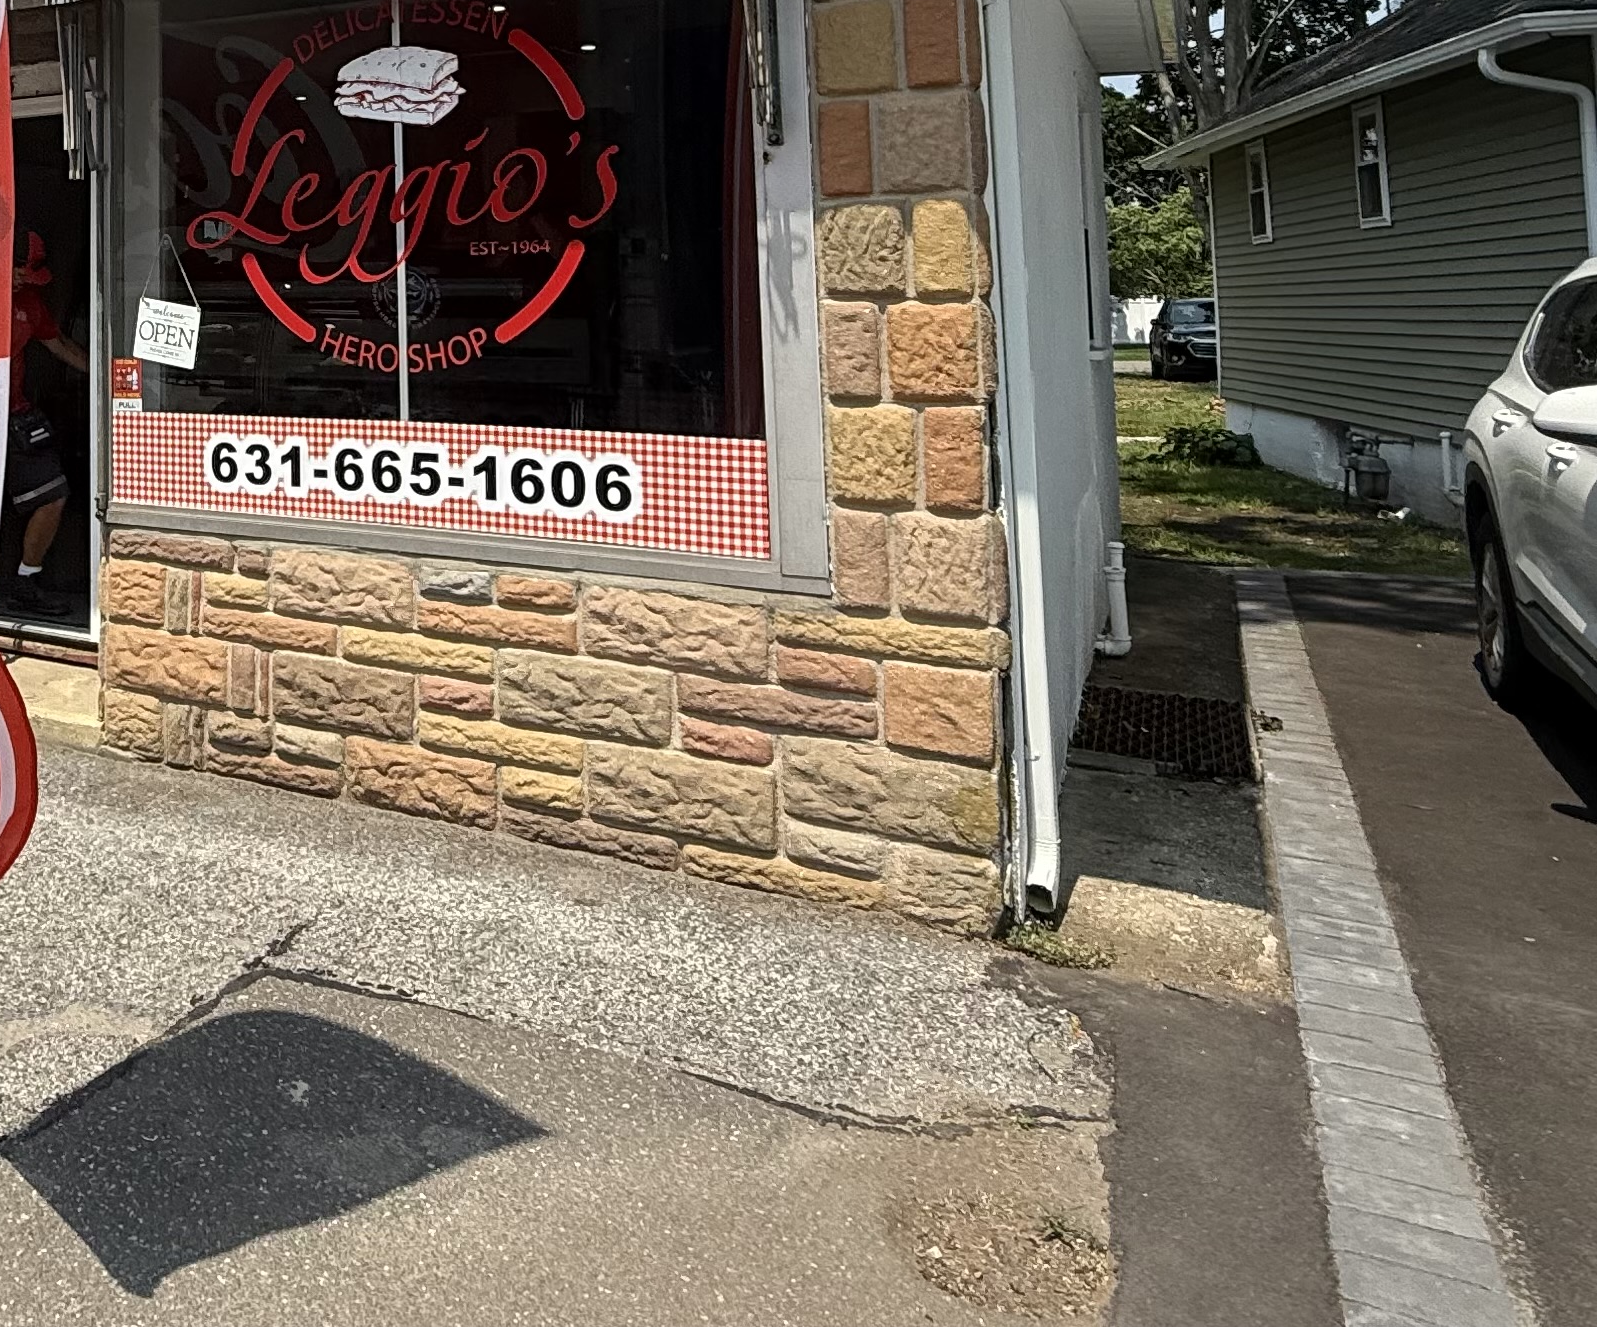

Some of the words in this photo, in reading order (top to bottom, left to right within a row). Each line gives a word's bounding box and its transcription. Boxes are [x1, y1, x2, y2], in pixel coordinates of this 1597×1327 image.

[186, 129, 619, 284] Leggio's
[139, 320, 195, 350] OPEN
[320, 323, 399, 373] HERO
[407, 327, 487, 373] SHOP
[211, 441, 633, 513] 631-665-1606
